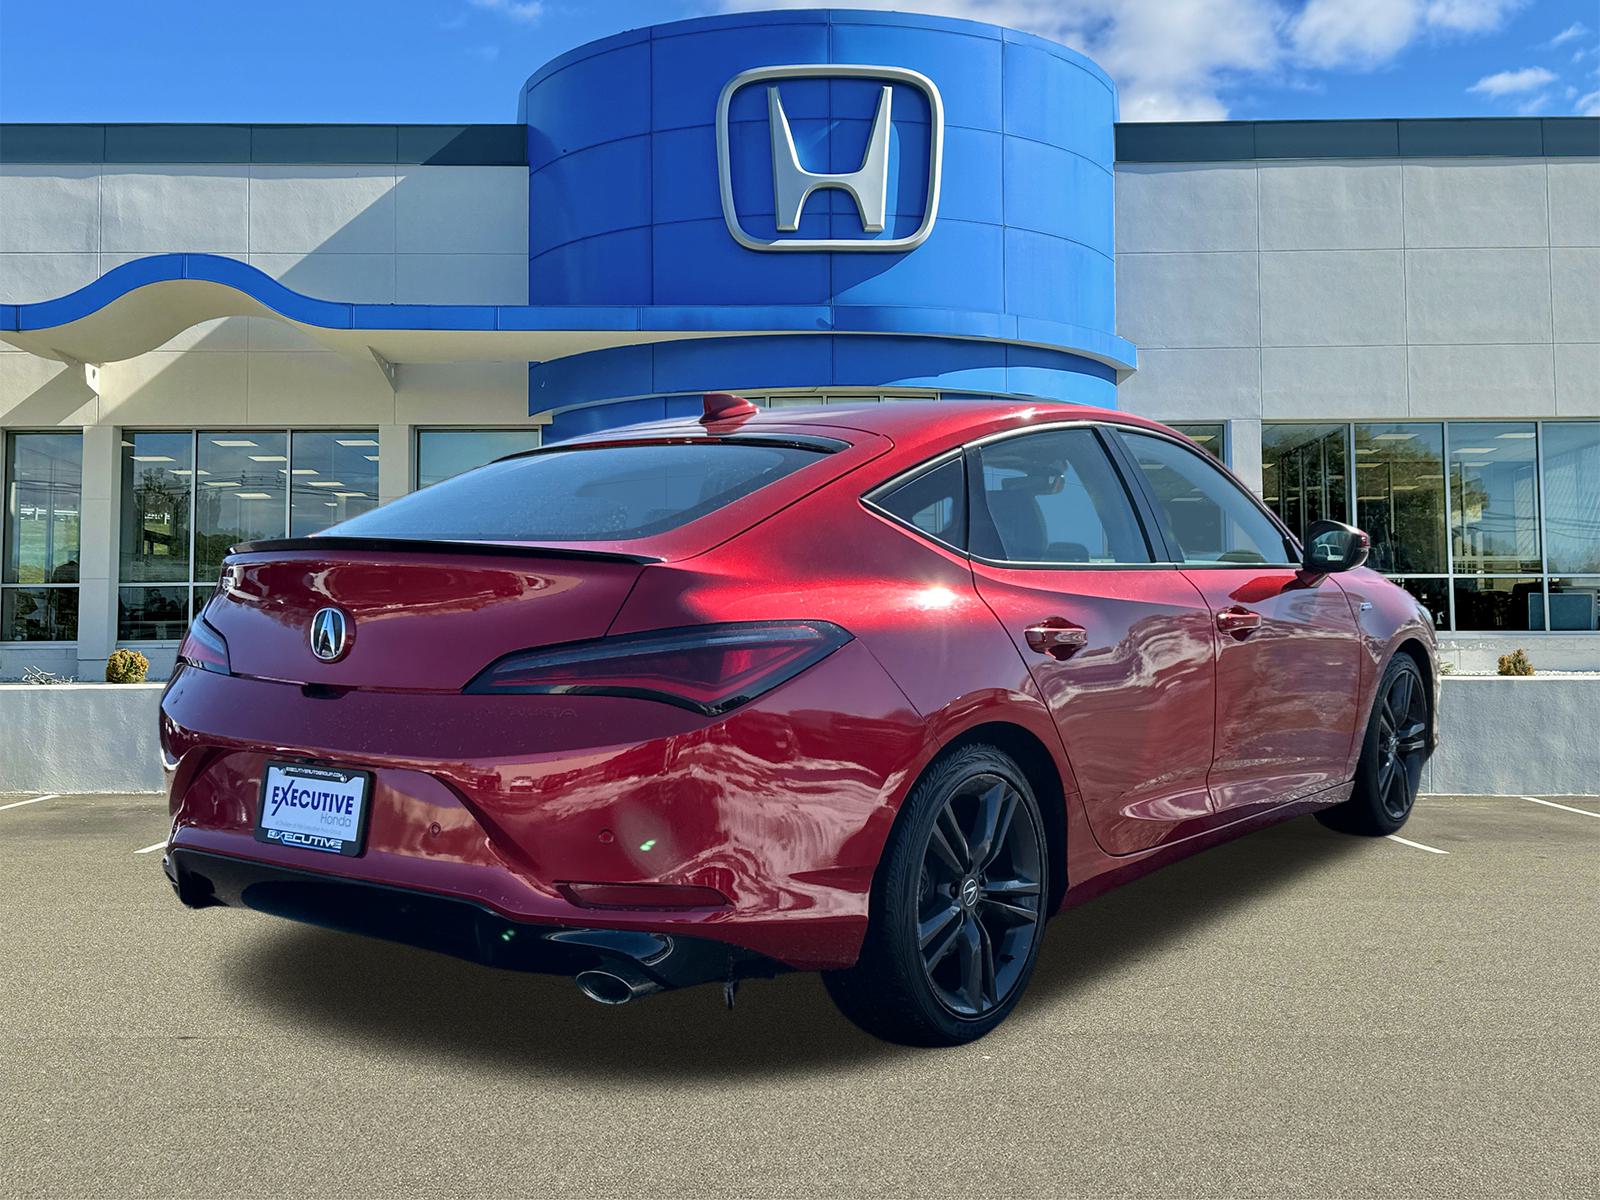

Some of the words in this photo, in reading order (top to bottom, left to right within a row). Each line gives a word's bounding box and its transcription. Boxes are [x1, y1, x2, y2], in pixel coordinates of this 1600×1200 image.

[271, 779, 355, 817] EXECUTIVE
[320, 813, 352, 828] Honda
[267, 829, 343, 850] EXECUTIVE
